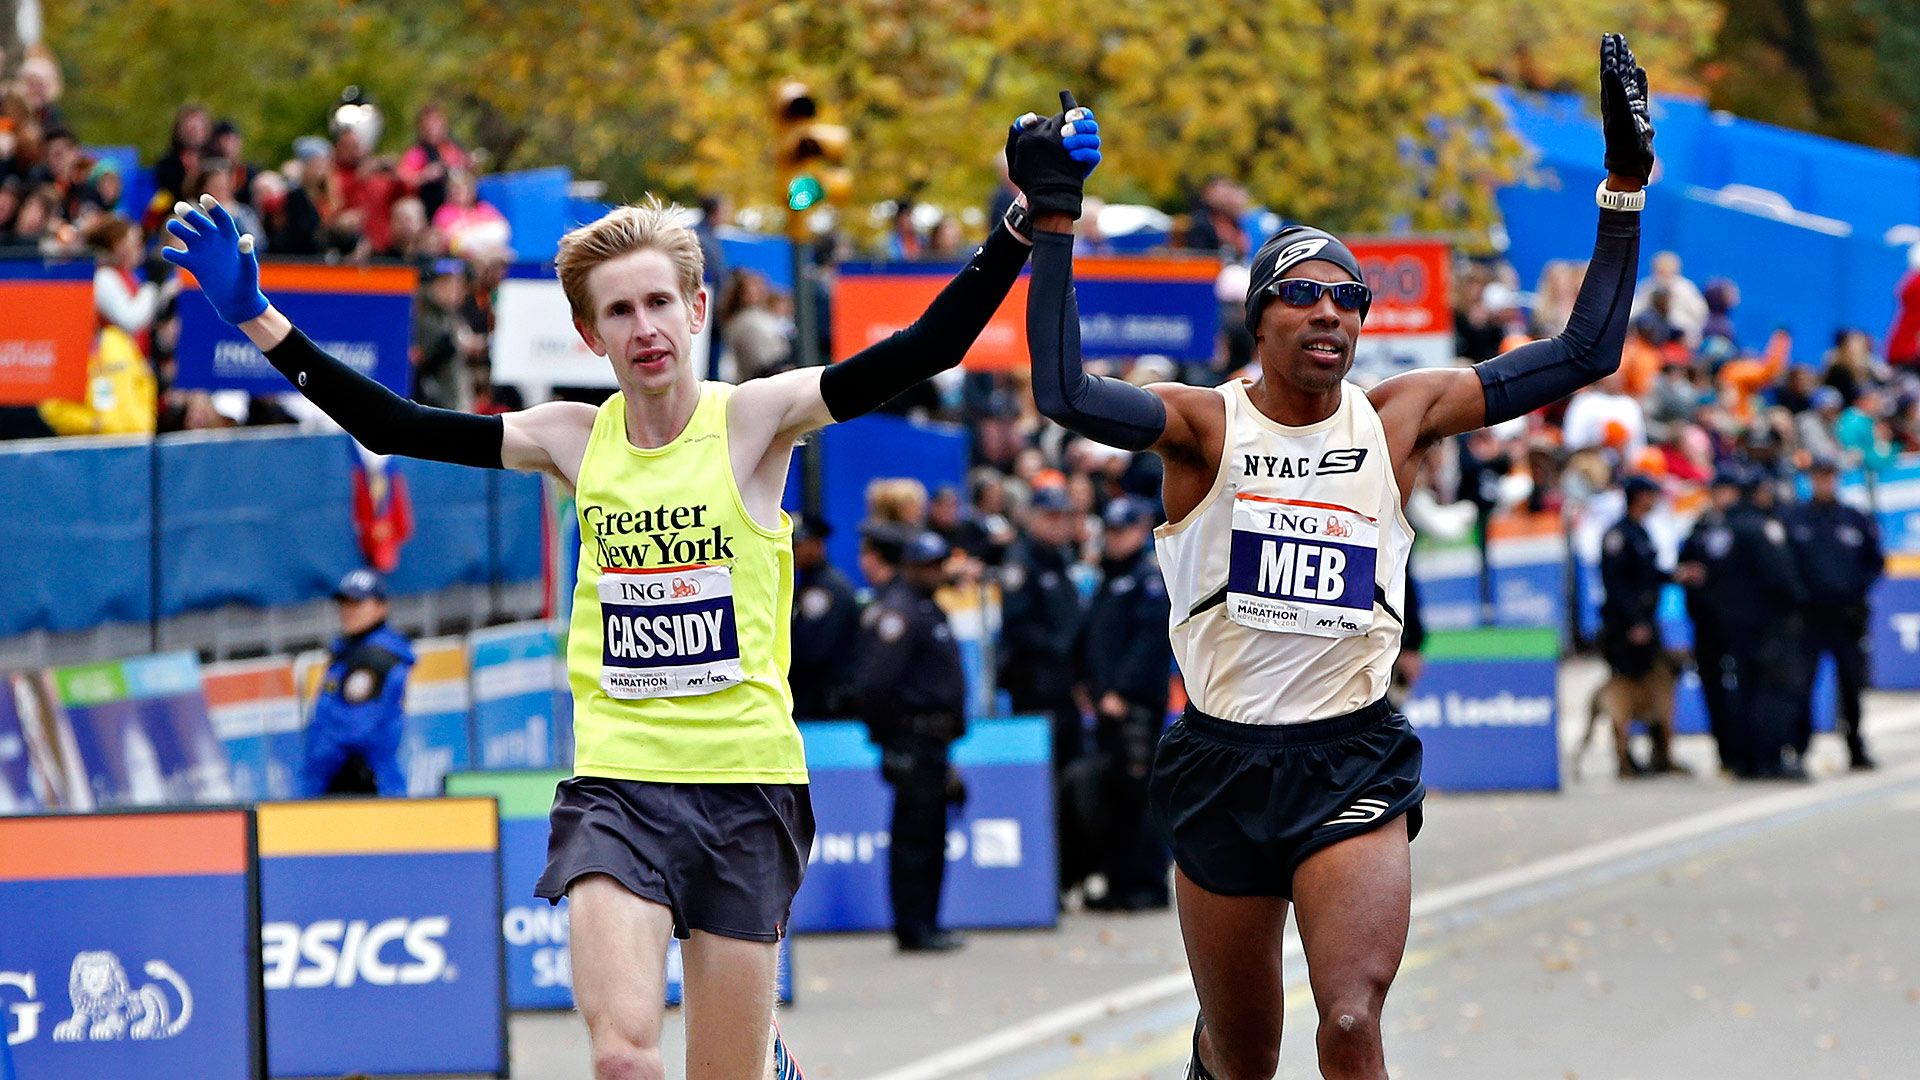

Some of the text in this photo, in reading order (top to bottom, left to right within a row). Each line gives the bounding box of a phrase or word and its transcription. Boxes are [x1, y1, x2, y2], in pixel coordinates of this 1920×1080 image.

[1243, 454, 1310, 479] NYAC
[583, 504, 707, 537] Greater
[1267, 511, 1319, 535] ING
[649, 525, 735, 566] York
[1256, 539, 1347, 601] MEB
[620, 581, 667, 601] ING
[1237, 604, 1298, 621] MARATHON
[607, 608, 724, 659] CASSIDY
[610, 677, 668, 688] MARATHON
